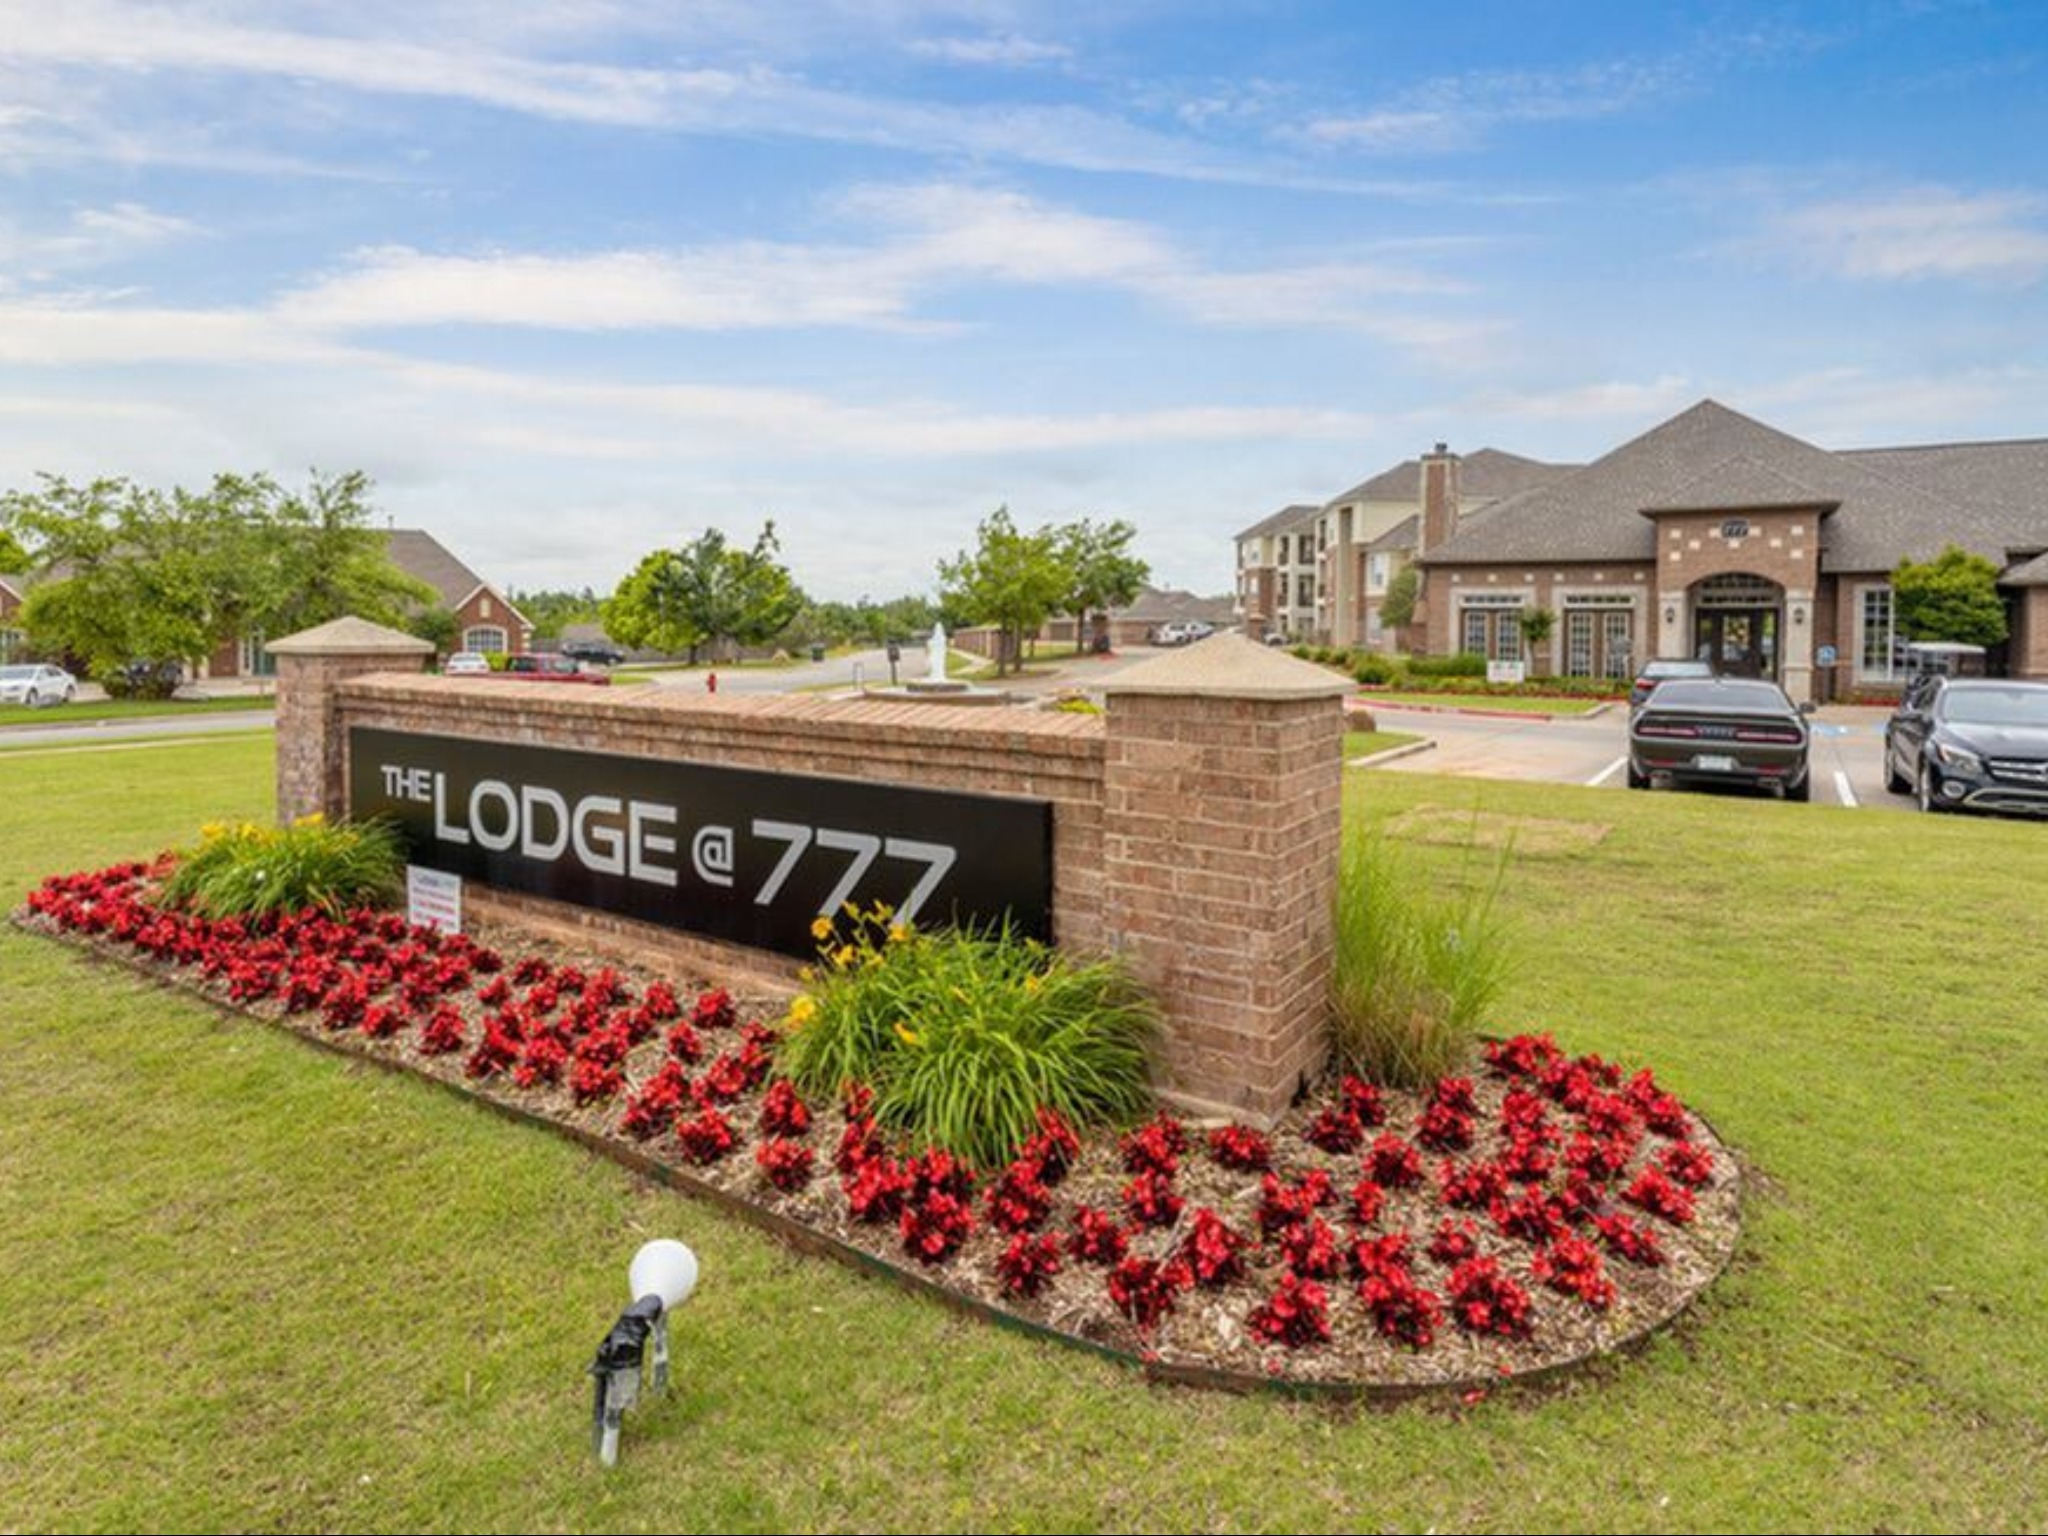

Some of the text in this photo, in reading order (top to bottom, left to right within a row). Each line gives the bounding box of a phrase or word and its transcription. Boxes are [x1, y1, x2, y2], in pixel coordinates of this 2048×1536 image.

[381, 764, 957, 926] THE LODGE @ 777
